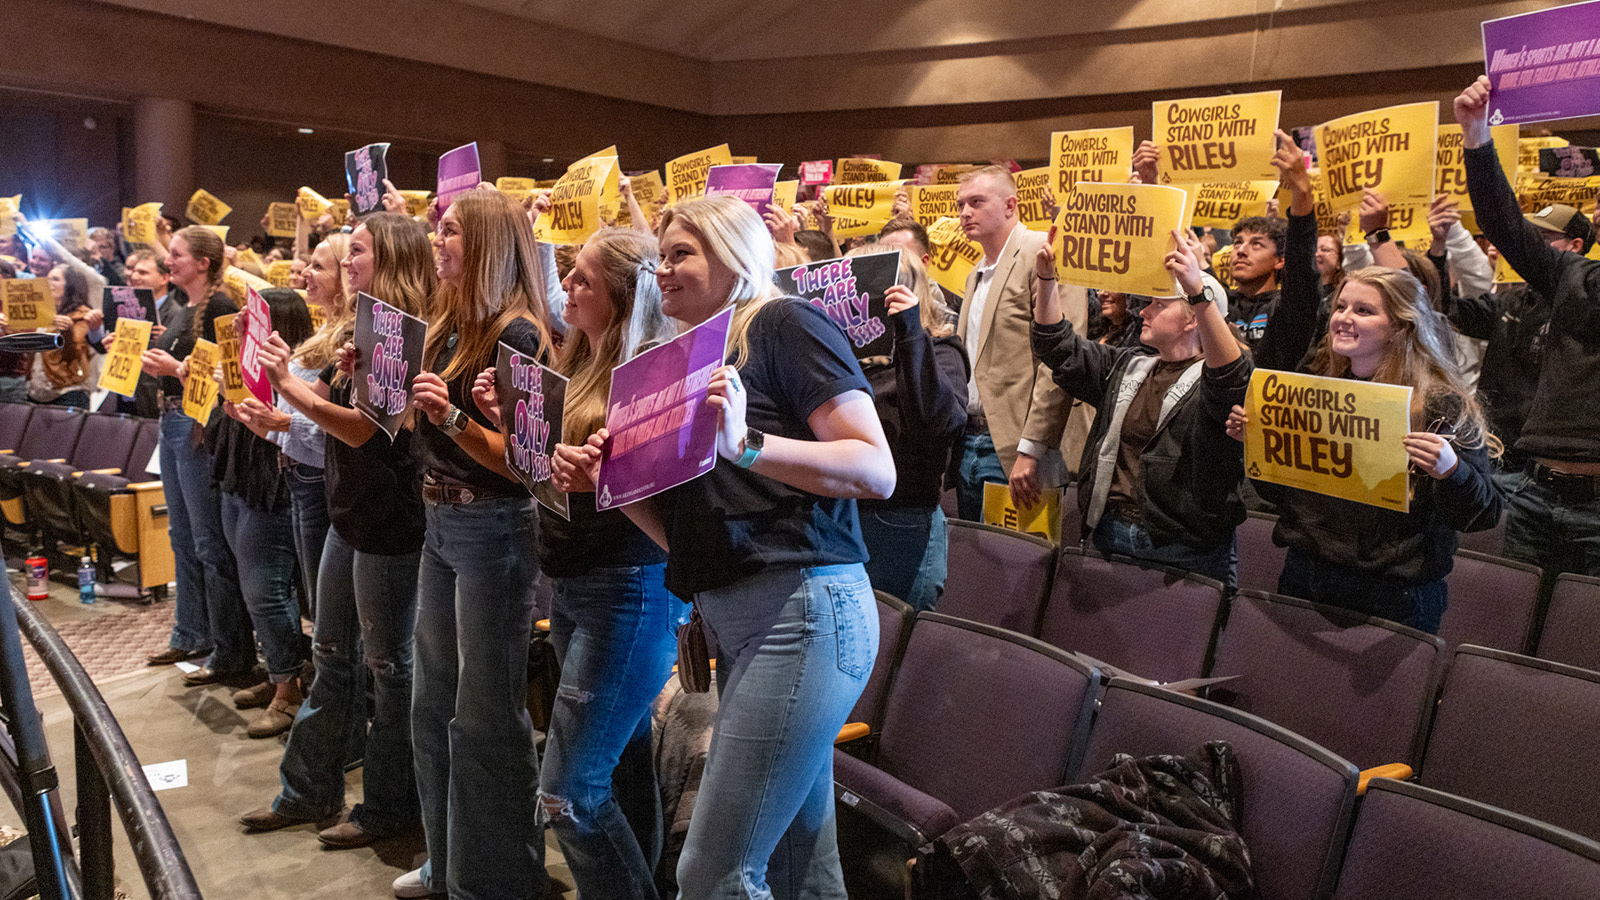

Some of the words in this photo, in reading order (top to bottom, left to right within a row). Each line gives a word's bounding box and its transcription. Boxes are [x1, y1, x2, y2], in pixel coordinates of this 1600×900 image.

[1168, 104, 1240, 124] COWGIRLS
[1061, 134, 1108, 152] COWGIRLS
[1166, 124, 1213, 143] STAND
[1219, 118, 1256, 138] WITH
[1323, 118, 1390, 148] COWGIRLS
[1060, 153, 1088, 168] STAND
[1092, 150, 1118, 166] WITH
[1168, 142, 1238, 170] RILEY
[1325, 142, 1360, 168] STAND
[1366, 132, 1410, 156] WITH
[672, 156, 711, 174] COWGIRLS
[673, 168, 699, 186] STAND
[842, 172, 865, 182] STAND
[868, 172, 887, 182] WITH
[843, 160, 880, 172] COWGIRLS
[1328, 158, 1383, 198] RILEY
[552, 182, 573, 200] STAND
[574, 180, 596, 198] WITH
[1016, 174, 1050, 189] COWGIR
[1198, 190, 1230, 200] STAND
[1233, 190, 1259, 200] WITH
[833, 188, 875, 209] RILEY
[919, 202, 947, 214] STAND
[1067, 185, 1136, 214] COWGIRLS
[1194, 200, 1242, 220] RILEY
[550, 201, 584, 230] RILEY
[1063, 212, 1110, 236] STAND
[1115, 214, 1154, 238] WITH
[949, 236, 980, 262] WITH
[1062, 235, 1132, 274] RILEY
[792, 257, 852, 294] THERE
[824, 276, 858, 307] ARE
[8, 304, 37, 320] RILEY
[372, 302, 403, 337] THERE
[848, 316, 886, 348] SEXES
[384, 336, 404, 360] ARE
[107, 354, 133, 380] RILEY
[372, 342, 408, 391] ONLY
[510, 354, 543, 394] THERE
[367, 374, 386, 408] TWO
[387, 387, 408, 416] SEXES
[528, 392, 544, 421] ARE
[1262, 374, 1356, 414] COWGIRLS
[514, 400, 550, 455] ONLY
[1260, 404, 1322, 434] STAND
[1329, 412, 1380, 442] WITH
[510, 434, 530, 474] TWO
[531, 451, 550, 482] SEXES
[1262, 429, 1352, 478] RILEY
